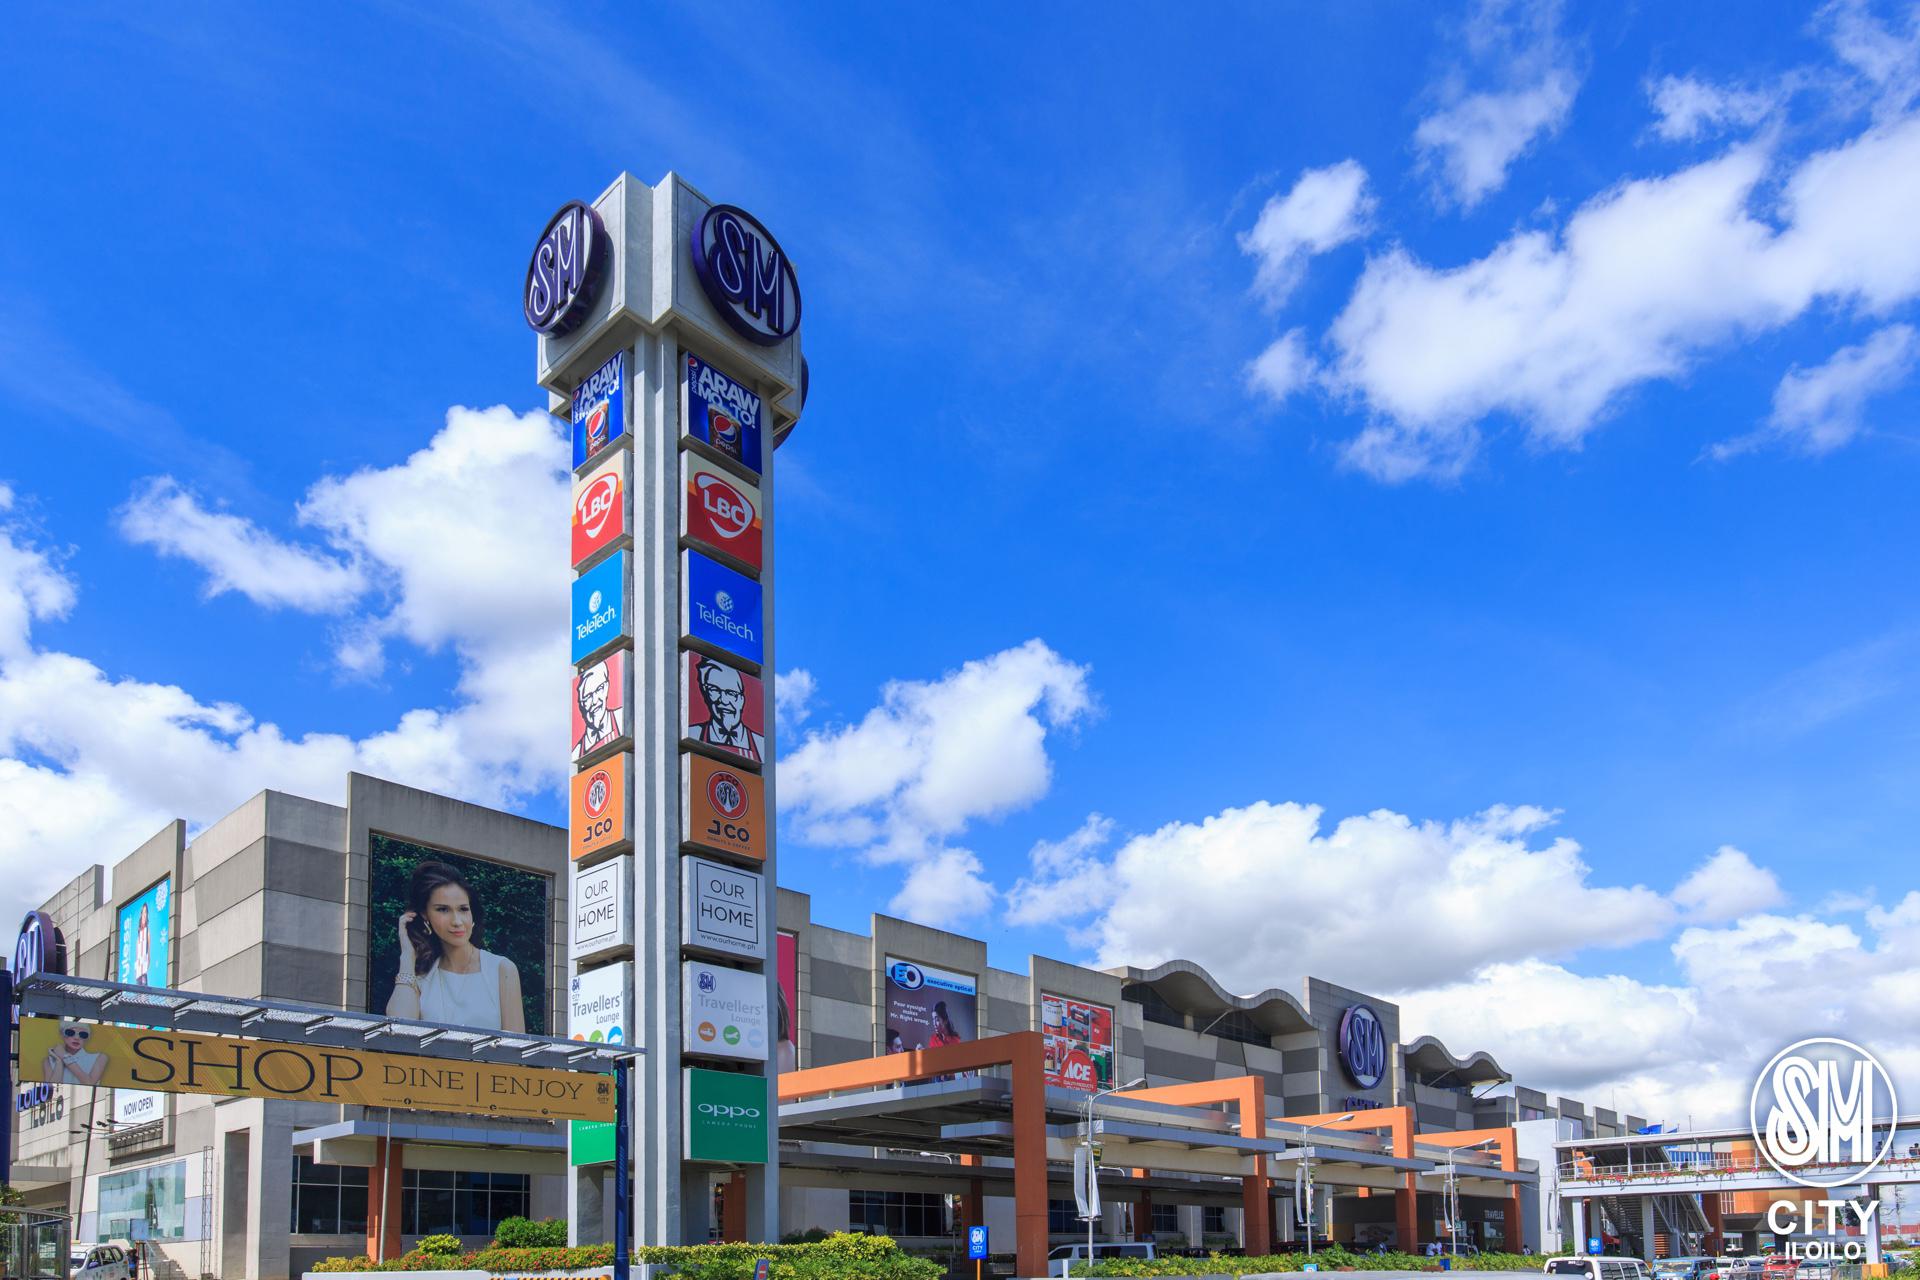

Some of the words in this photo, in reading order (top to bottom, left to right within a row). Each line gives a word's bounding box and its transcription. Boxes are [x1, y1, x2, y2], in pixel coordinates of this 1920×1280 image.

[529, 206, 584, 326] SM
[710, 212, 785, 334] SM
[580, 352, 622, 406] ARAW
[699, 366, 760, 416] ARAW
[582, 489, 611, 525] LBC
[704, 489, 745, 527] LBC
[576, 605, 616, 640] TeleTech
[696, 602, 754, 642] TeleTech
[585, 879, 609, 899] OUR
[710, 879, 744, 899] OUR
[578, 903, 614, 929] HOME
[701, 902, 753, 928] HOME
[577, 934, 616, 951] www.ourhome.ph
[700, 933, 756, 951] www.ourhome.ph
[927, 979, 953, 988] executive
[954, 984, 973, 993] optical
[596, 1012, 619, 1024] Lounge
[731, 1014, 760, 1026] Lounge
[900, 1014, 913, 1022] Right
[907, 1003, 927, 1012] eyesight
[1350, 1013, 1381, 1077] SM
[131, 1036, 364, 1098] SHOP
[1064, 1060, 1092, 1081] ACE
[383, 1065, 464, 1091] DINE
[490, 1075, 583, 1100] ENJOY
[16, 1083, 49, 1112] ILOILO
[124, 1101, 137, 1116] NOW
[138, 1096, 154, 1111] OPEN
